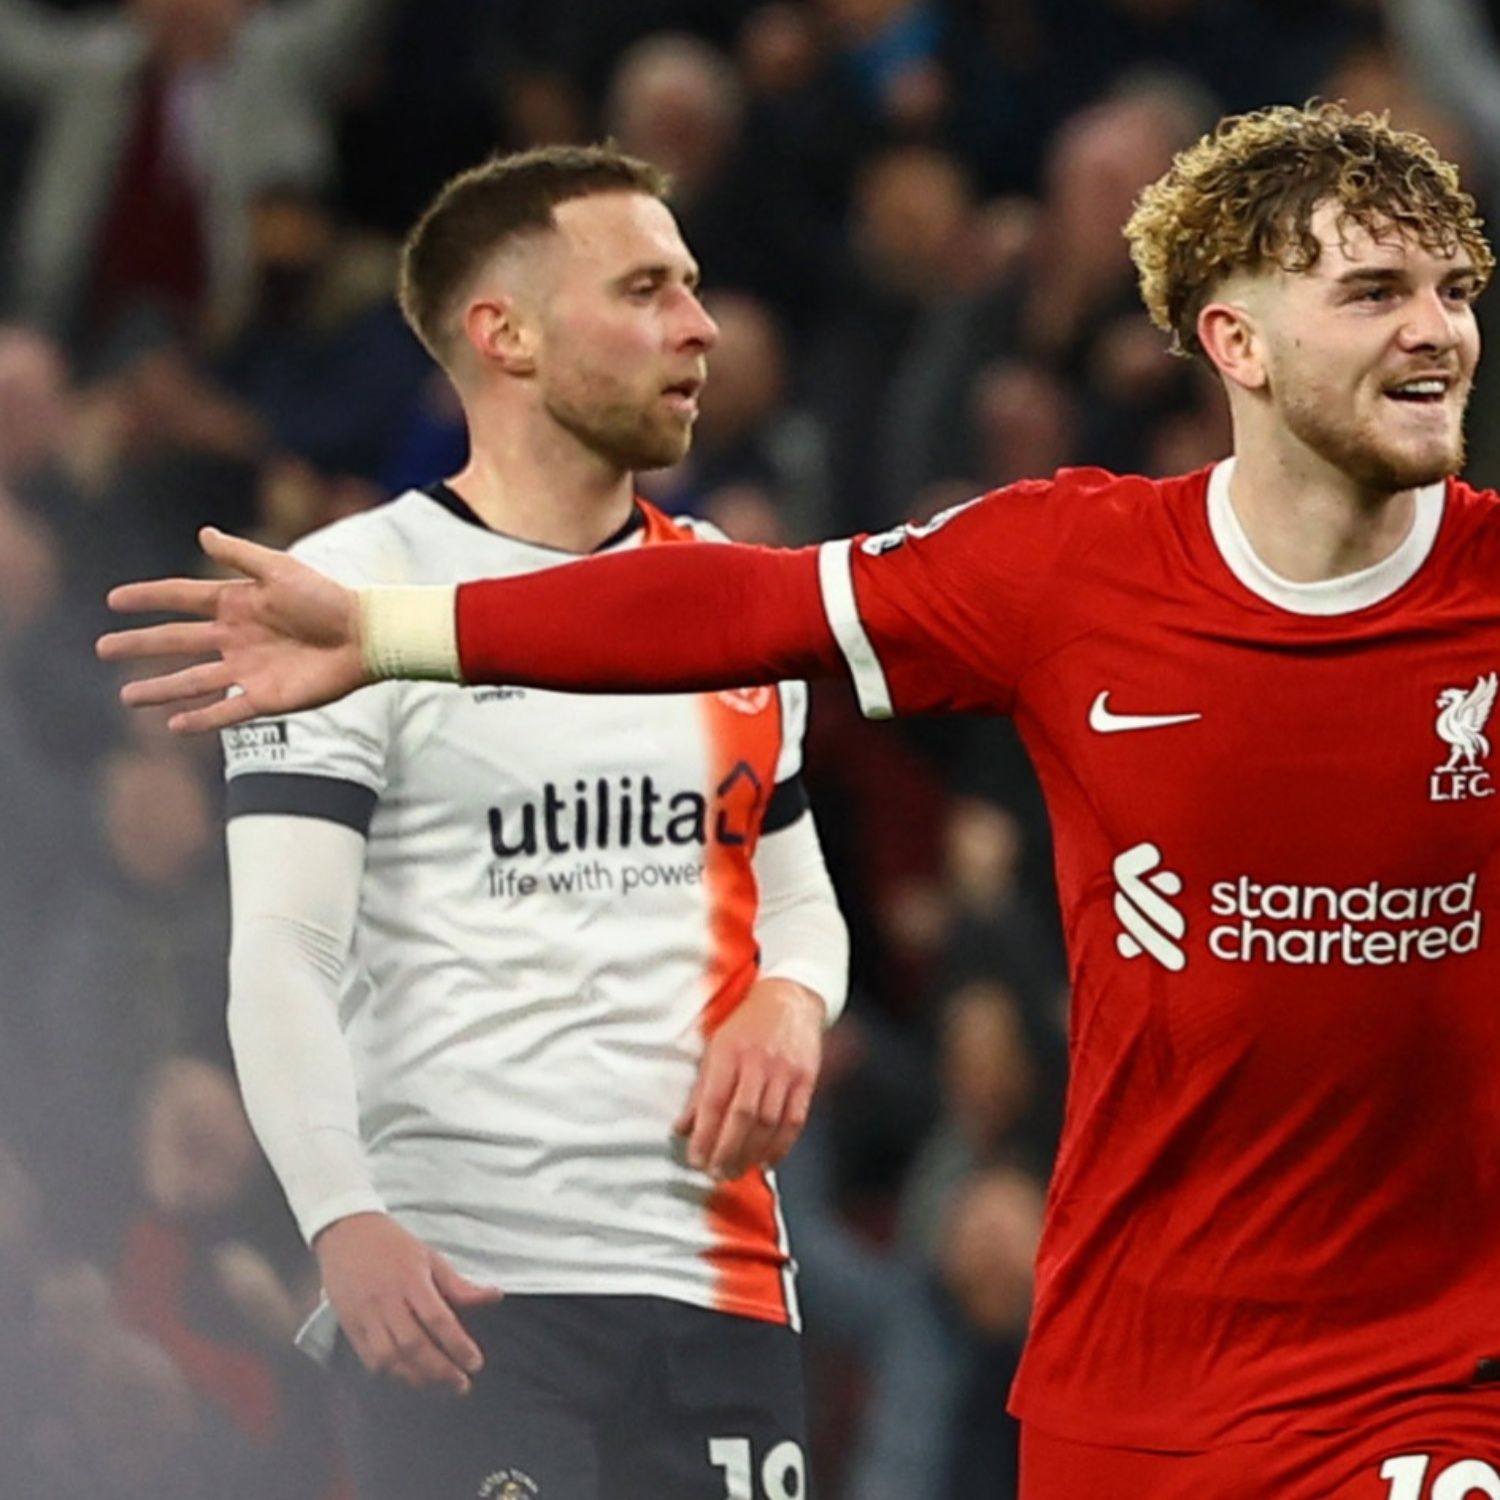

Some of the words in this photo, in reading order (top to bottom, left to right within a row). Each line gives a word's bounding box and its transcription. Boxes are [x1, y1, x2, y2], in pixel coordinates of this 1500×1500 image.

[488, 775, 707, 858] utilita
[488, 866, 538, 899] life
[548, 860, 613, 894] with
[622, 864, 705, 895] power
[1210, 872, 1477, 921] standard
[1209, 910, 1481, 965] chartered
